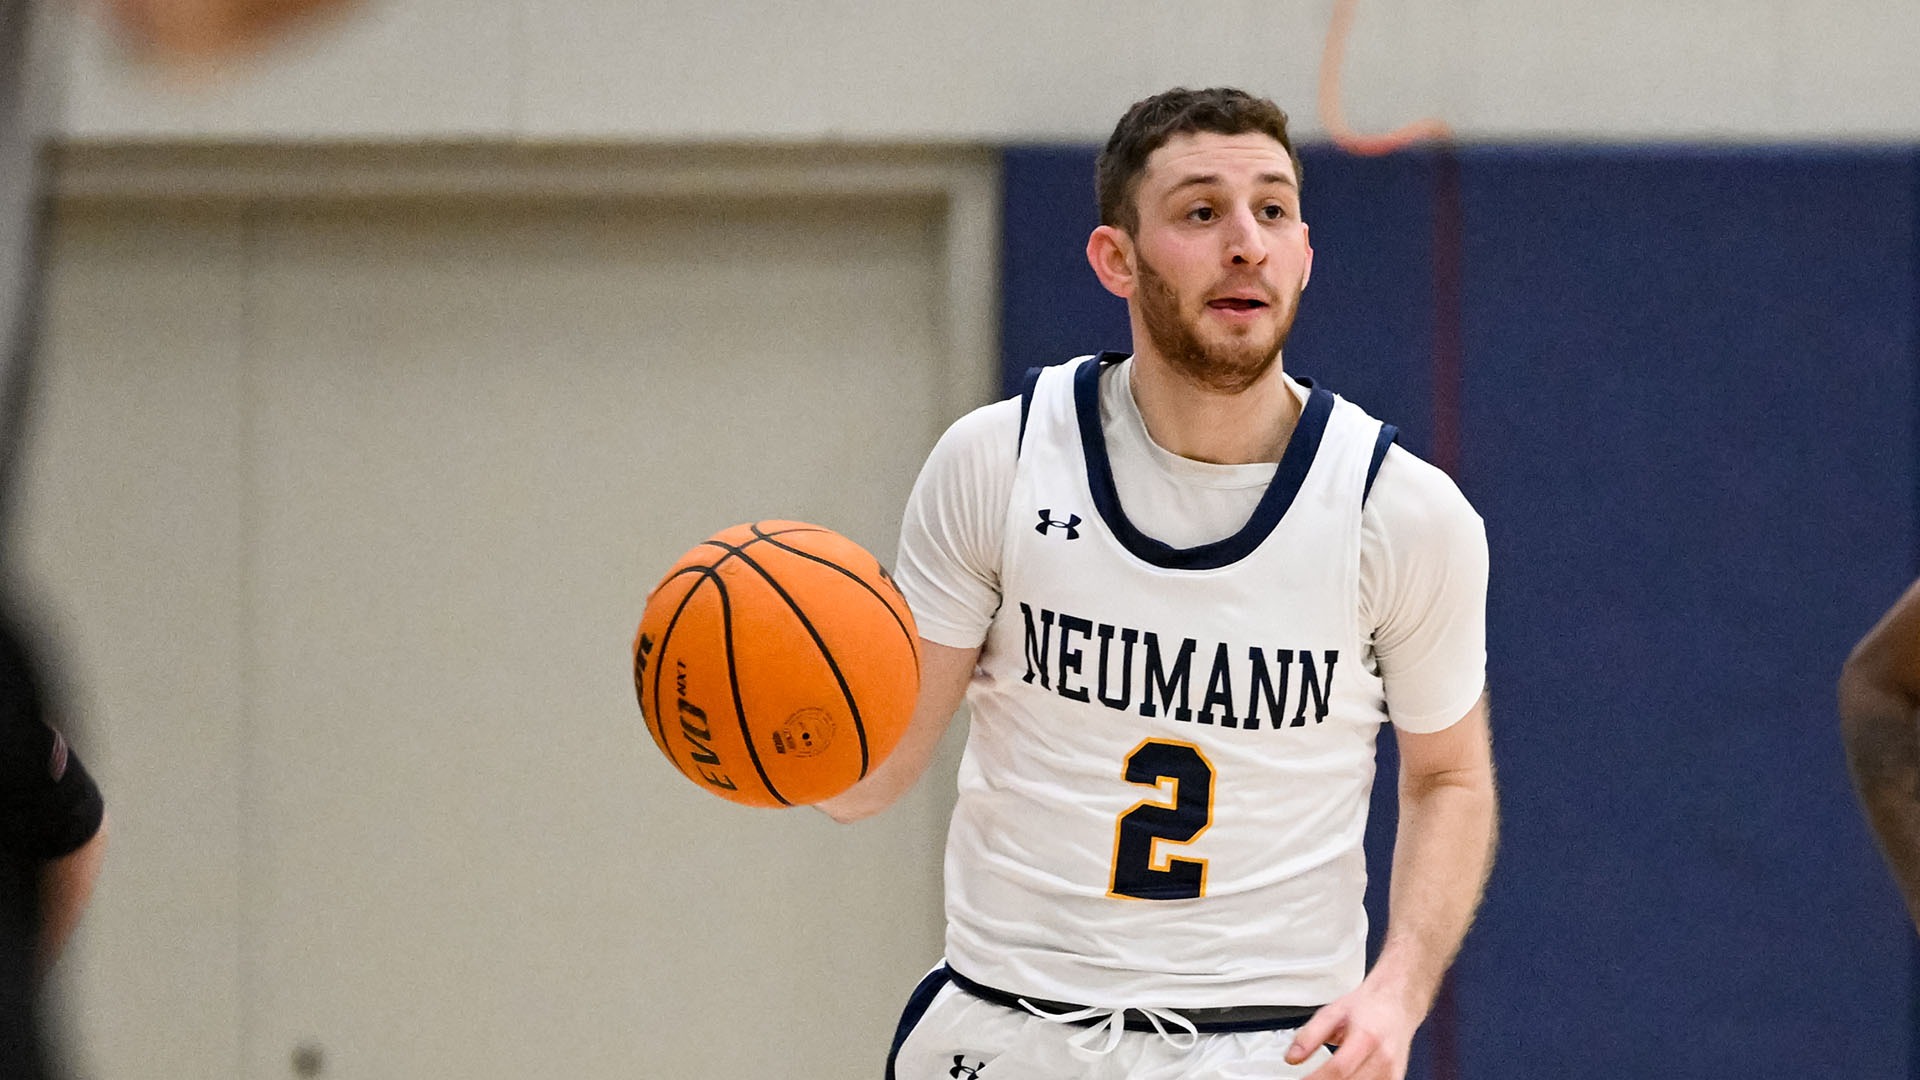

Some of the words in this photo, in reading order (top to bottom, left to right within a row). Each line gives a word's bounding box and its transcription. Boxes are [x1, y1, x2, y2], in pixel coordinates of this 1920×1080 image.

[676, 660, 687, 697] NXT
[1019, 601, 1339, 730] NEUMANN
[677, 697, 738, 791] EVO
[1105, 736, 1217, 901] 2
